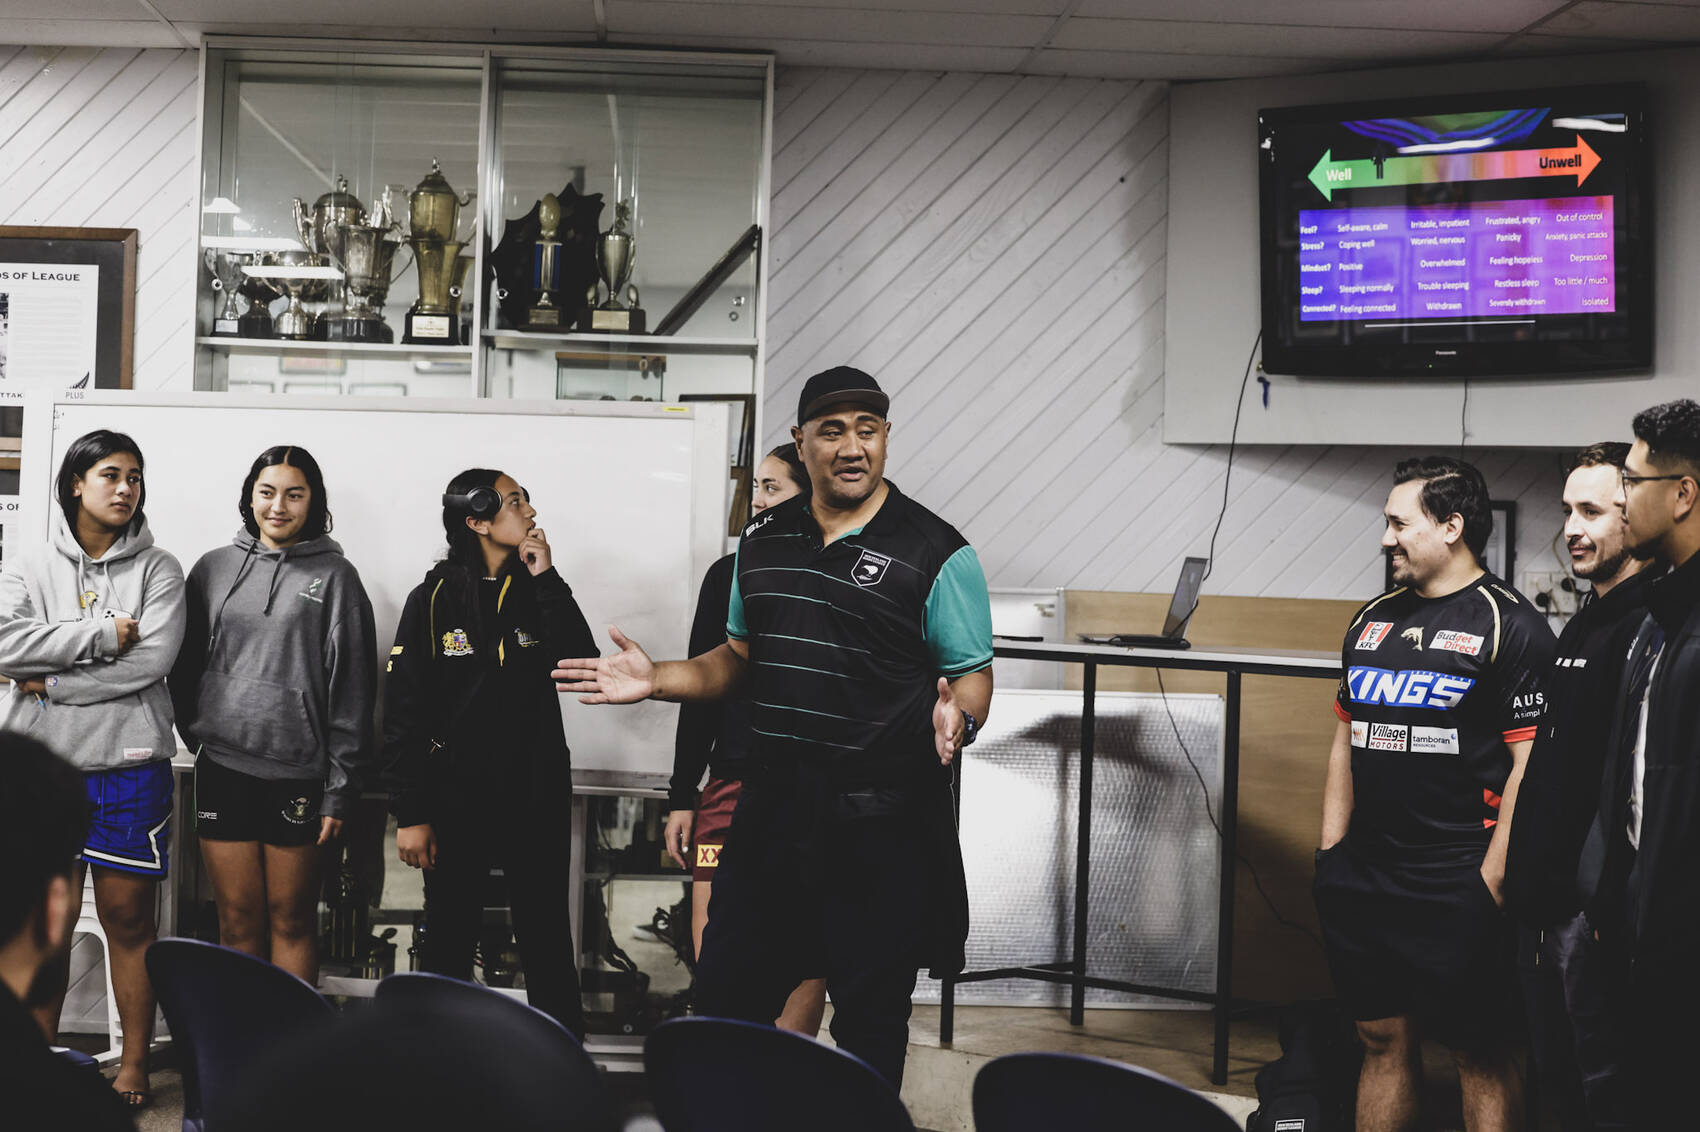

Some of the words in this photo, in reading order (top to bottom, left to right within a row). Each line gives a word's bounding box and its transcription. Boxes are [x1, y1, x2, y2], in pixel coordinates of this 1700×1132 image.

[1539, 154, 1582, 168] Unwell
[1326, 167, 1352, 182] Well
[1485, 216, 1521, 225] Frustrated,
[1522, 216, 1542, 225] angry
[1556, 214, 1570, 222] Out
[1571, 213, 1578, 221] of
[1579, 213, 1603, 221] control
[1337, 223, 1372, 233] Self-aware,
[1373, 222, 1389, 231] calm
[1410, 219, 1438, 229] Irritable,
[1439, 218, 1470, 229] impatient
[1300, 225, 1318, 234] Feel?
[1496, 233, 1522, 243] Panicky
[1569, 232, 1585, 241] panic
[1586, 231, 1608, 239] attacks
[1301, 241, 1325, 251] Stress?
[1338, 240, 1361, 250] Coping
[1362, 239, 1375, 248] well
[1410, 237, 1438, 246] Worried,
[1439, 237, 1466, 245] nervous
[1419, 258, 1466, 268] Overwhelmed
[1489, 256, 1513, 266] Feeling
[1514, 256, 1544, 266] hopeless
[1570, 253, 1608, 263] Depression
[1301, 263, 1332, 272] Mindset?
[1338, 263, 1364, 271] Positive
[12, 272, 29, 280] OF
[1554, 277, 1567, 286] Too
[1567, 277, 1583, 285] little
[1588, 276, 1608, 285] much
[1339, 285, 1366, 294] Sleeping
[1366, 283, 1394, 293] normally
[1417, 282, 1442, 291] Trouble
[1443, 281, 1470, 291] sleeping
[1494, 279, 1521, 288] Restless
[1521, 279, 1540, 288] sleep
[1301, 286, 1324, 295] Sleep?
[1426, 302, 1462, 311] Withdrawn
[1489, 299, 1515, 308] Severely
[1515, 298, 1546, 307] withdrawn
[1302, 304, 1336, 313] Connected?
[1340, 304, 1363, 314] Feeling
[1363, 303, 1397, 312] connected
[65, 391, 85, 399] PLUS
[745, 513, 775, 537] BLK
[1437, 632, 1474, 643] Budget
[1443, 640, 1477, 655] Direct
[1347, 668, 1471, 708] KINGS
[1513, 692, 1544, 709] AUS
[1372, 724, 1406, 741] Village
[1412, 735, 1451, 745] tamboran
[1369, 742, 1404, 751] MOTORS
